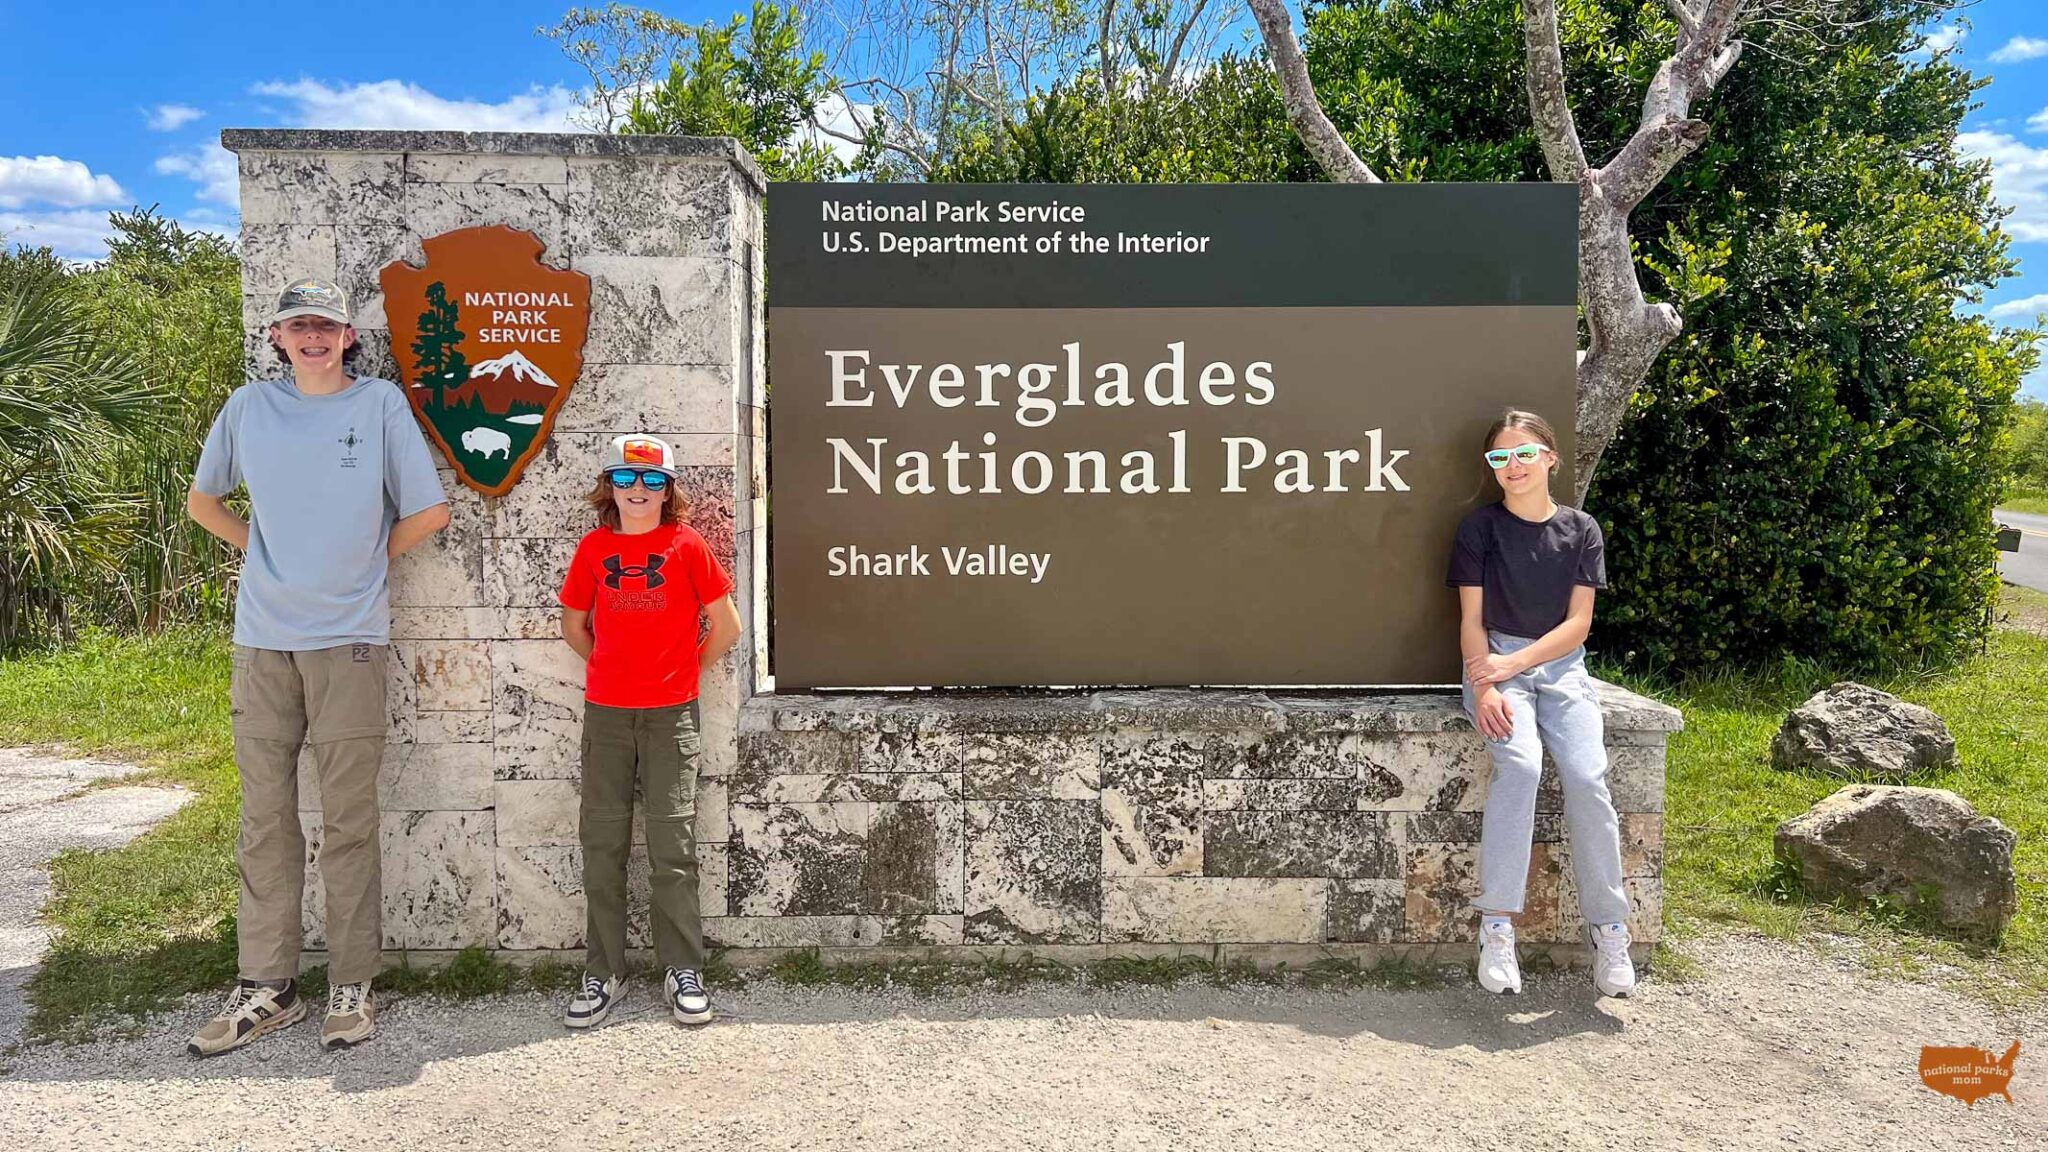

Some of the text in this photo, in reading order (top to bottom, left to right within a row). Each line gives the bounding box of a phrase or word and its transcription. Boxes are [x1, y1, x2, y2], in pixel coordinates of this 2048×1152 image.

[822, 199, 1086, 222] National Park Service
[822, 230, 1210, 258] U.S. Department of the Interior
[464, 292, 574, 307] NATIONAL
[492, 310, 548, 325] PARK
[478, 328, 561, 343] SERVICE
[824, 340, 1276, 428] Everglades
[826, 427, 1411, 495] National Park
[828, 544, 1051, 584] Shark Valley
